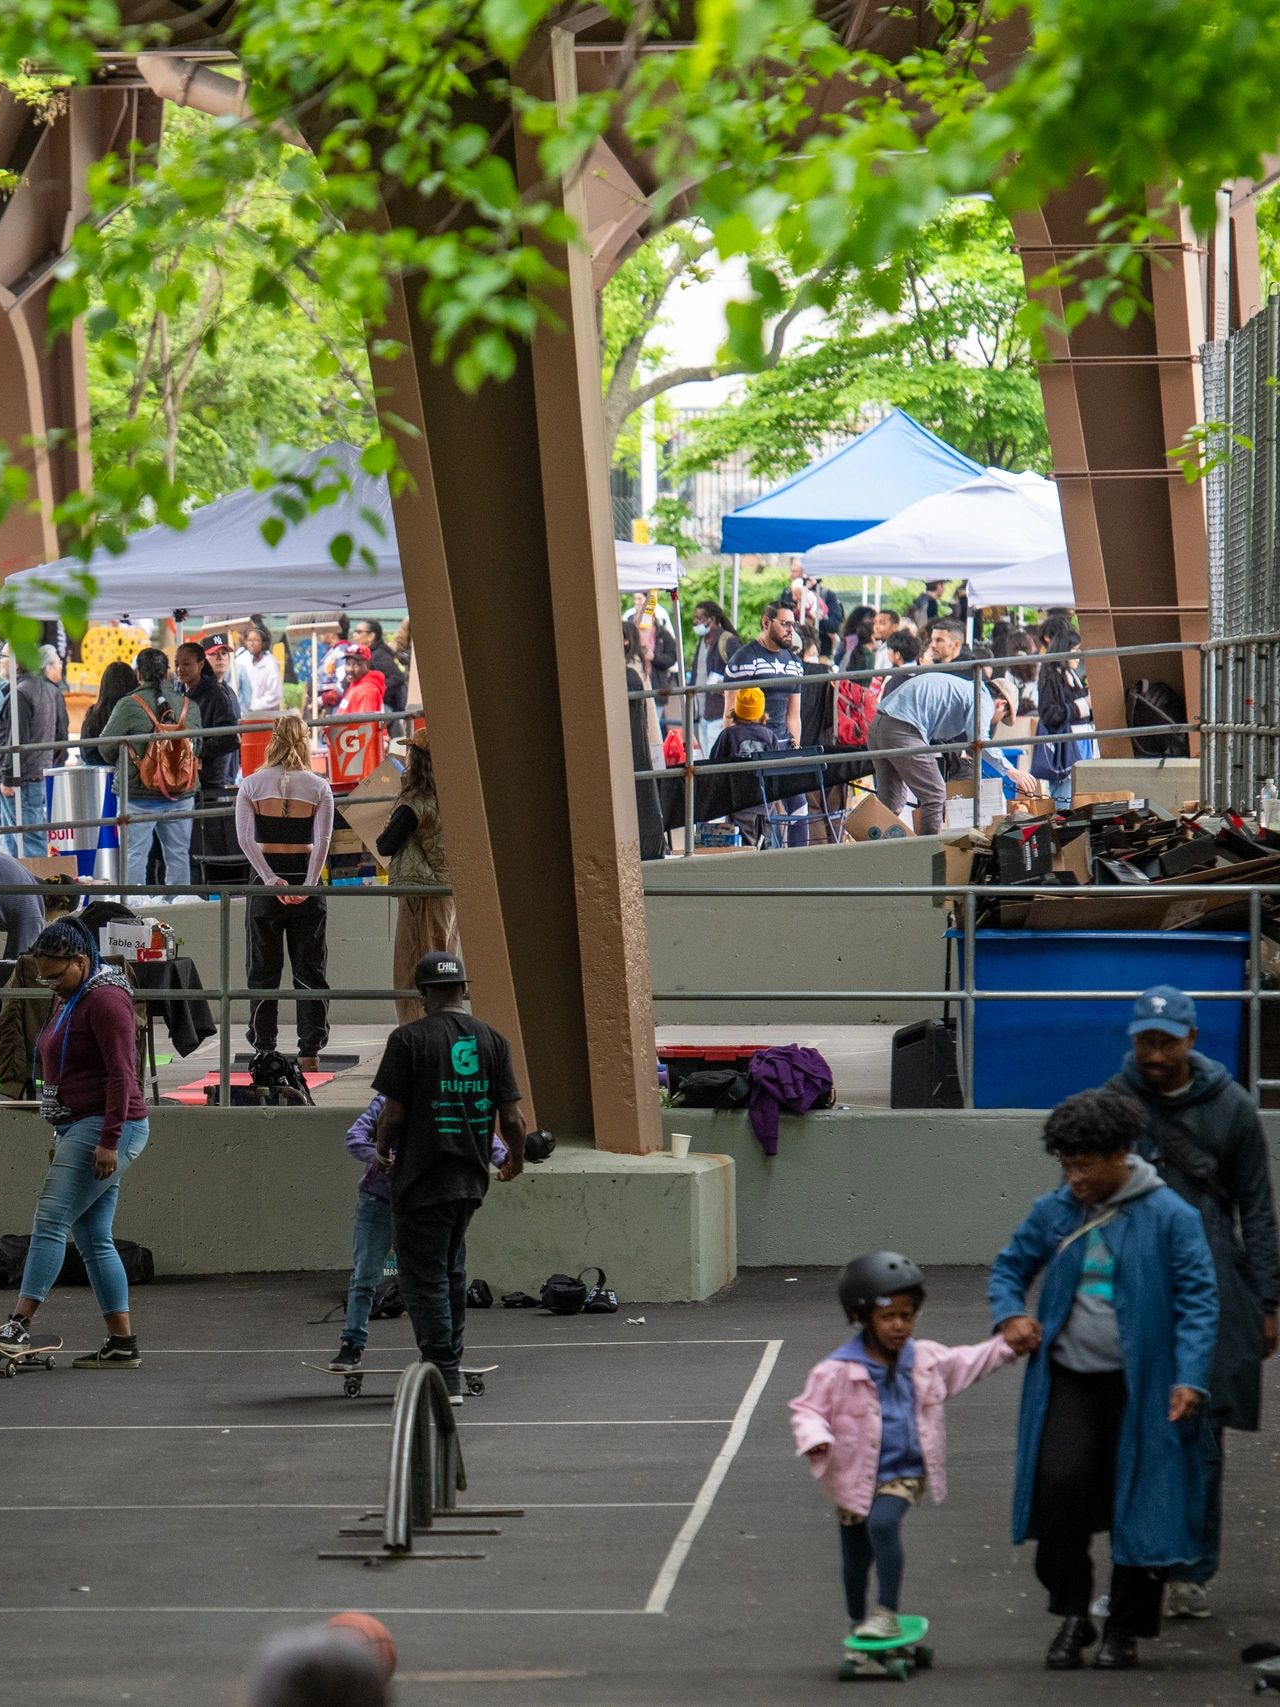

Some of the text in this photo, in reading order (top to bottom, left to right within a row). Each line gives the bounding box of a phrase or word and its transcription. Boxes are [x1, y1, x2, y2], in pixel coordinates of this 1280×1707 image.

[340, 730, 360, 753] G
[108, 937, 146, 949] Table 34
[437, 961, 459, 971] CHILL
[451, 1039, 480, 1076] G
